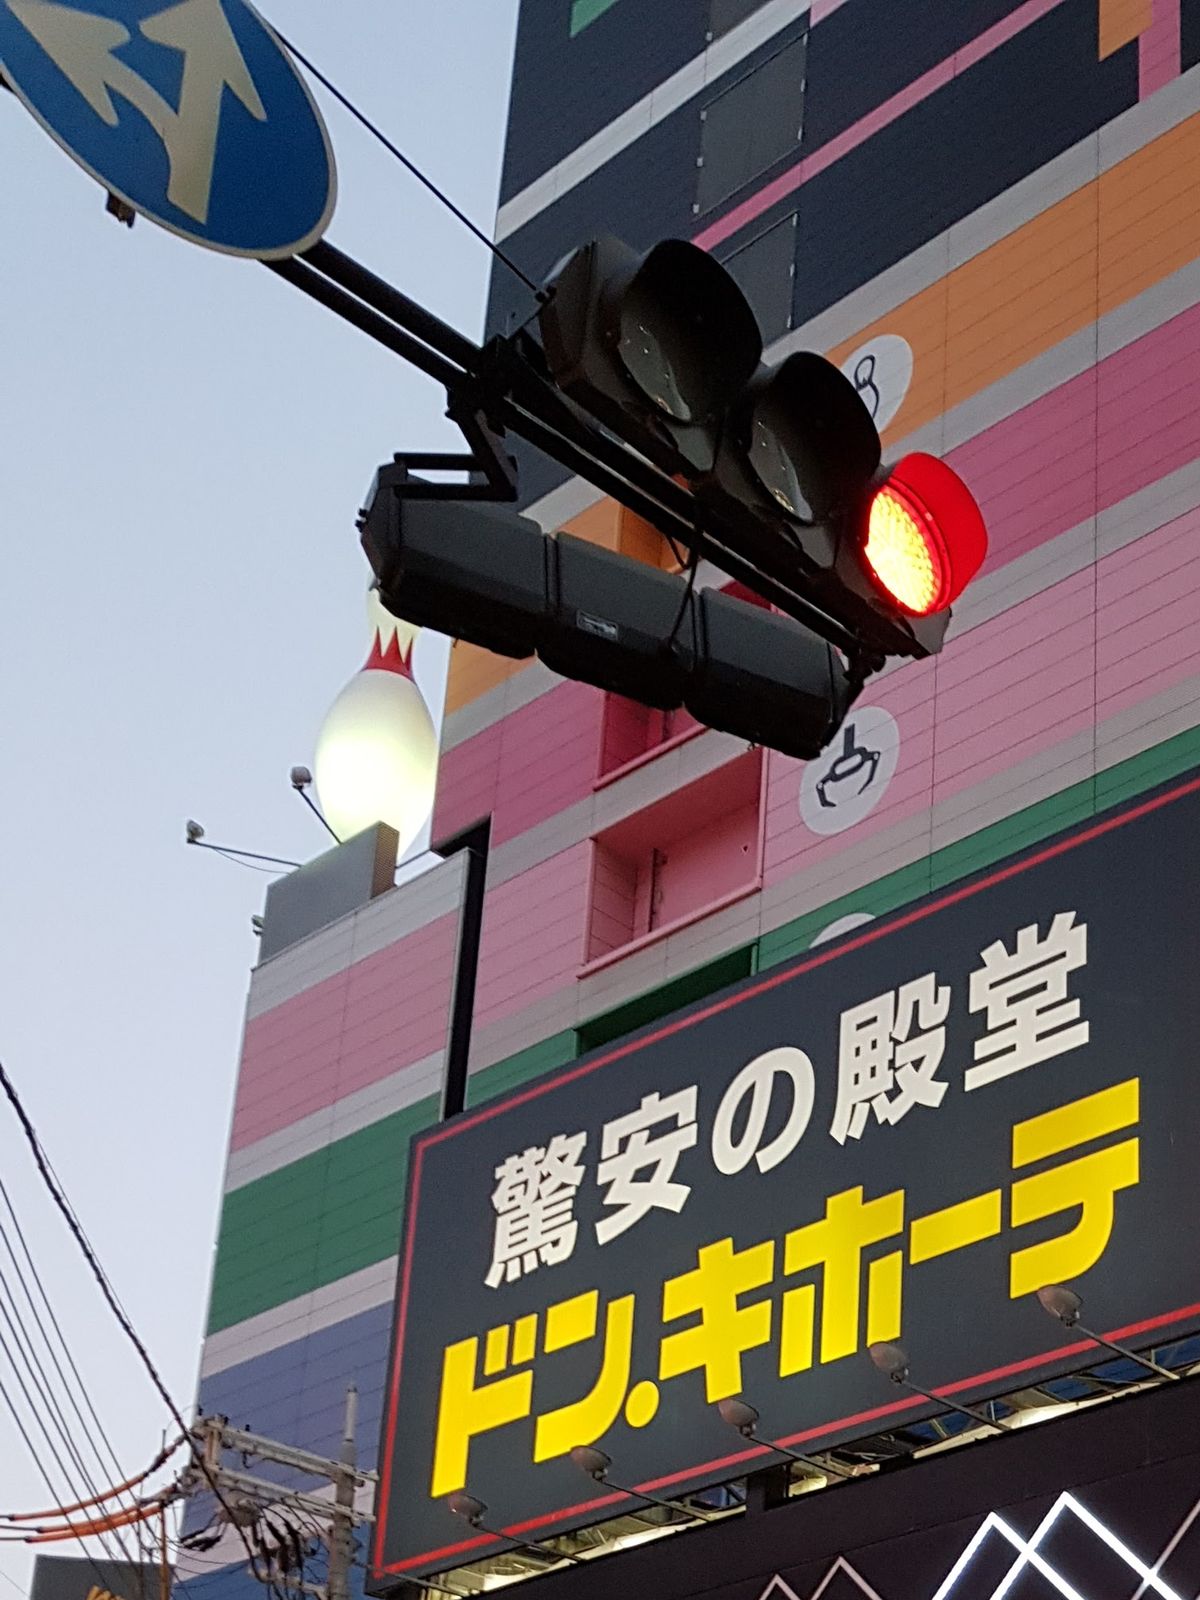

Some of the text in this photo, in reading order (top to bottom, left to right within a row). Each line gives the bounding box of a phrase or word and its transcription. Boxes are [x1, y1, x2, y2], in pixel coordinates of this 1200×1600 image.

[485, 909, 1091, 1290] 驚安の殿堂
